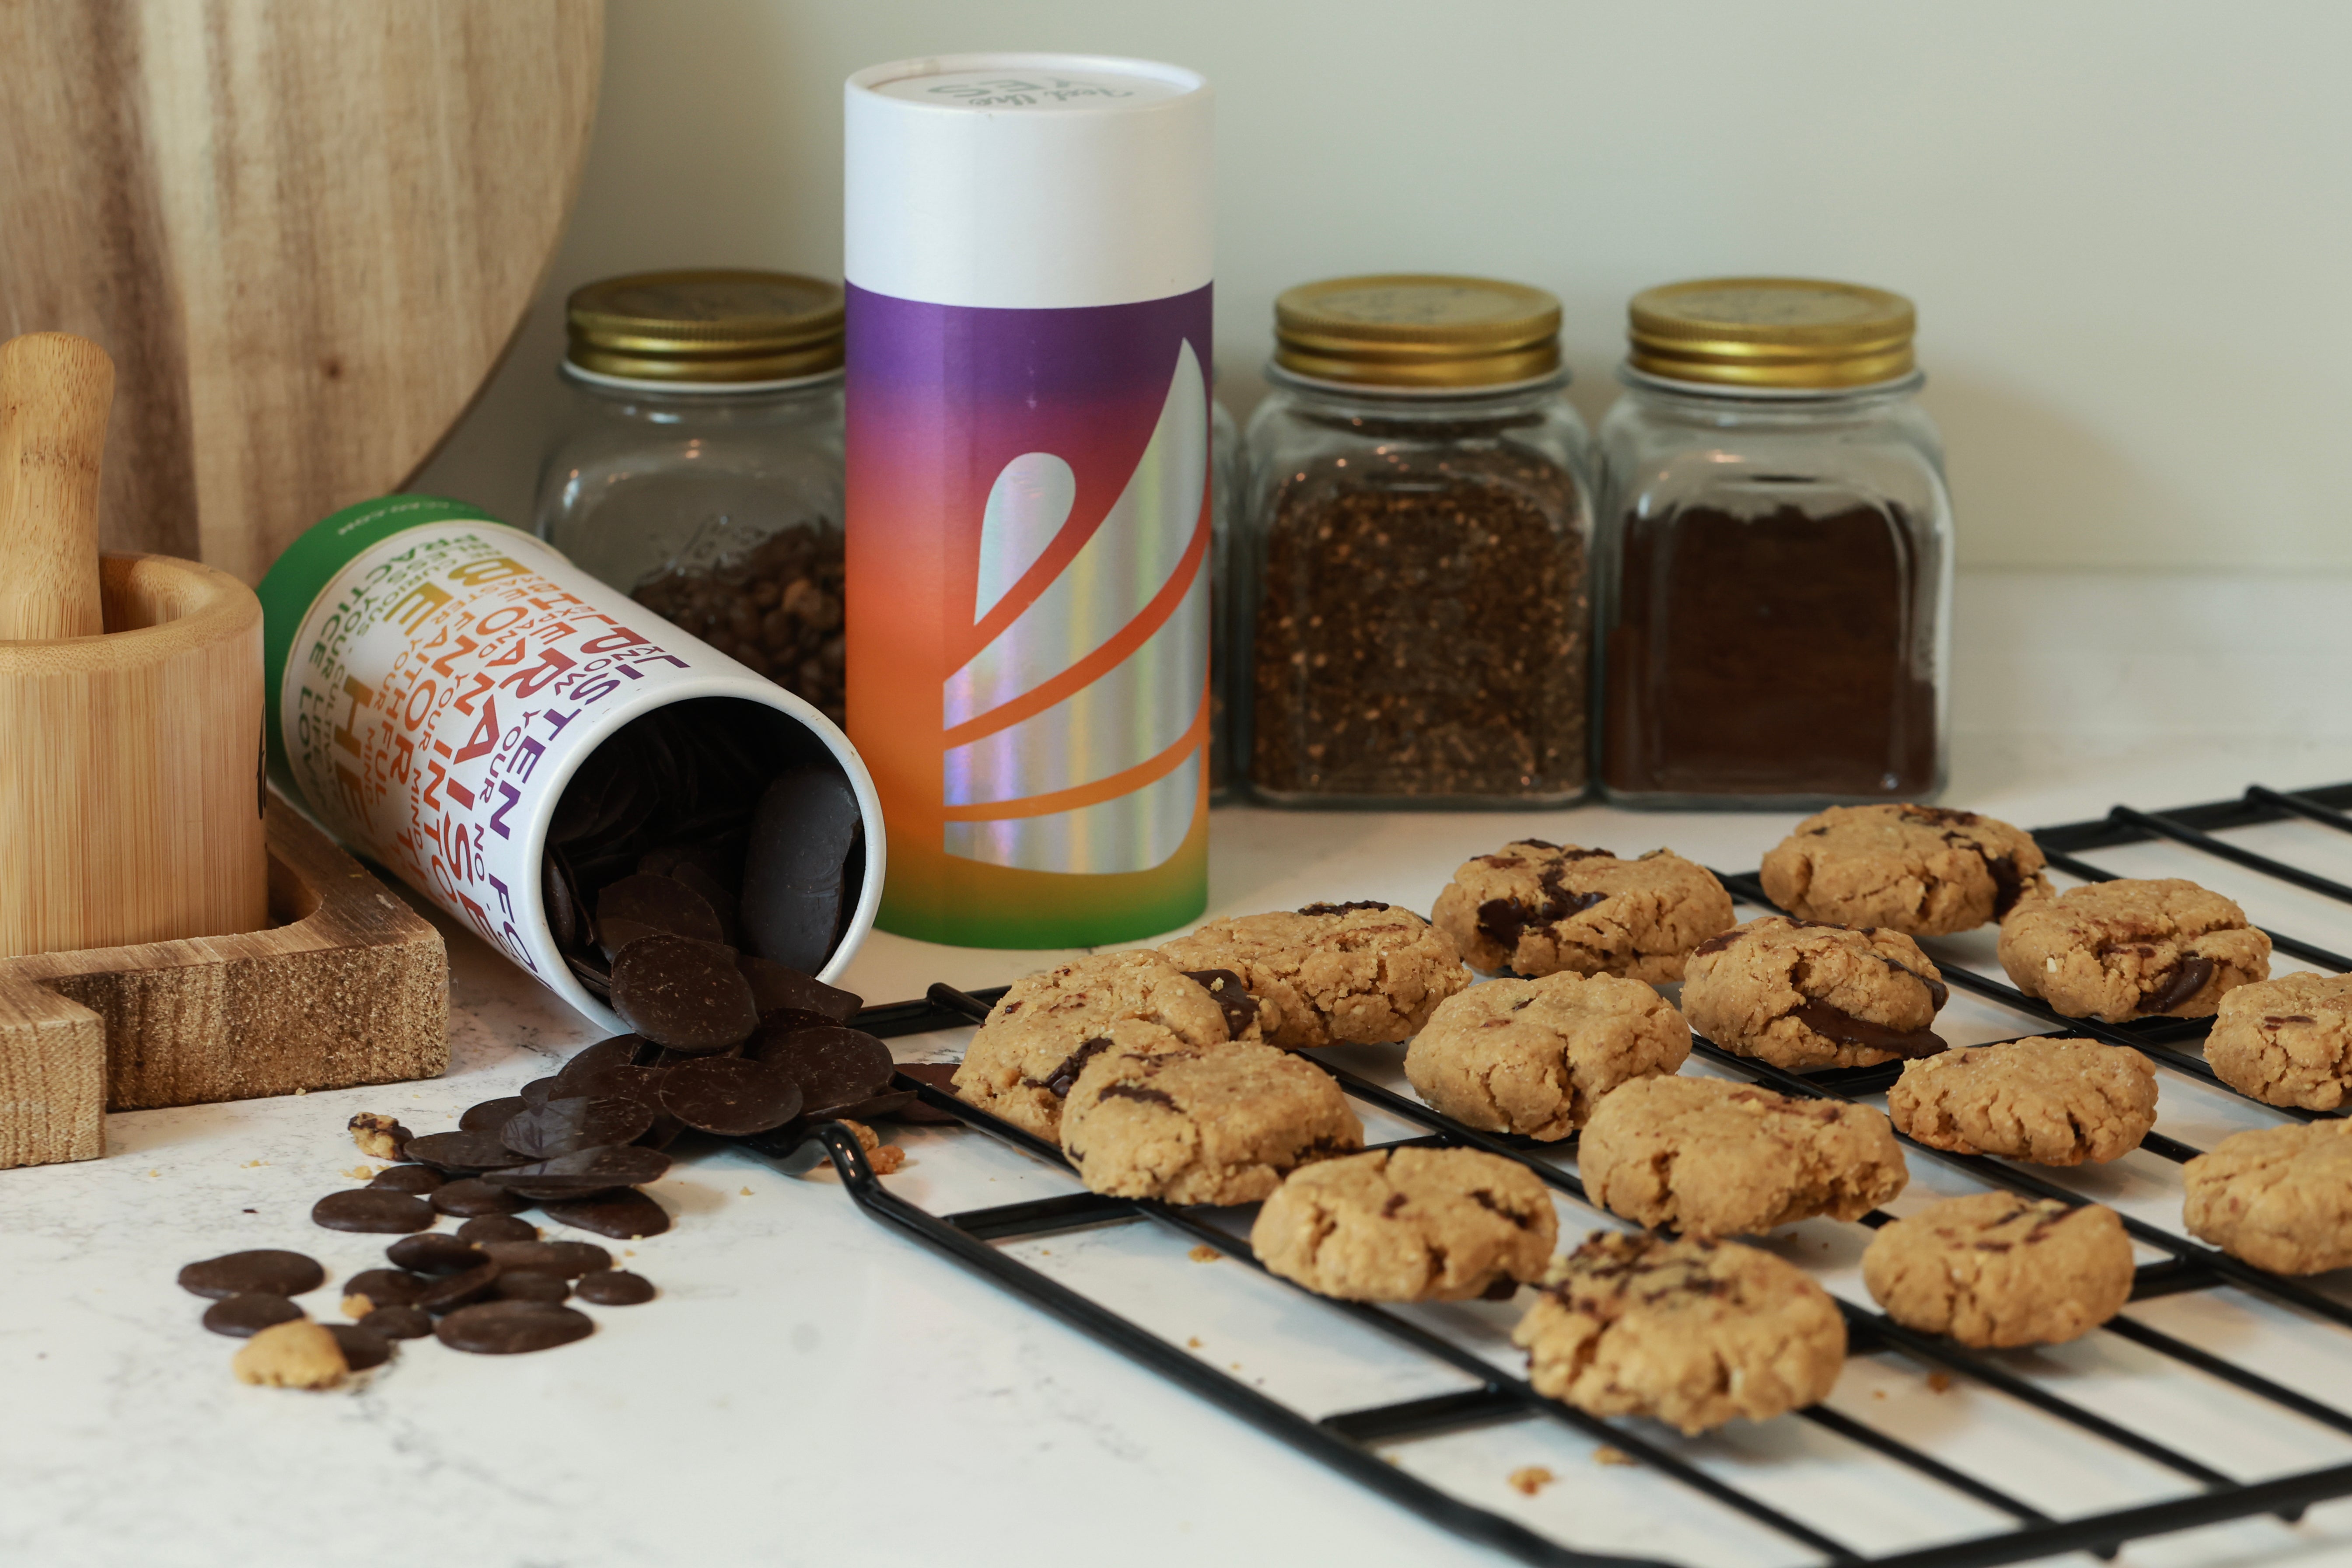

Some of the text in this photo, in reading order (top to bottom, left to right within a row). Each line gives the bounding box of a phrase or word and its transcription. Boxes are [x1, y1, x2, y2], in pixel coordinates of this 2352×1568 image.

[927, 76, 1104, 97] YES
[309, 534, 479, 668] PRACTICE
[321, 596, 379, 679] YOUR
[356, 559, 457, 637] CURIOUS
[383, 558, 534, 637] BE
[498, 583, 562, 602] BE
[334, 674, 377, 838] HE
[364, 575, 545, 804] MASTER YOUR MIND
[375, 611, 476, 806] FAITHFUL
[390, 593, 584, 785] HONOR
[411, 606, 596, 849] EXPAND YOUR MIND
[423, 614, 619, 903] LEAN INTO
[474, 646, 666, 881] KNOW YOUR NO
[490, 655, 691, 840] LISTEN
[444, 627, 652, 954] PRAISE
